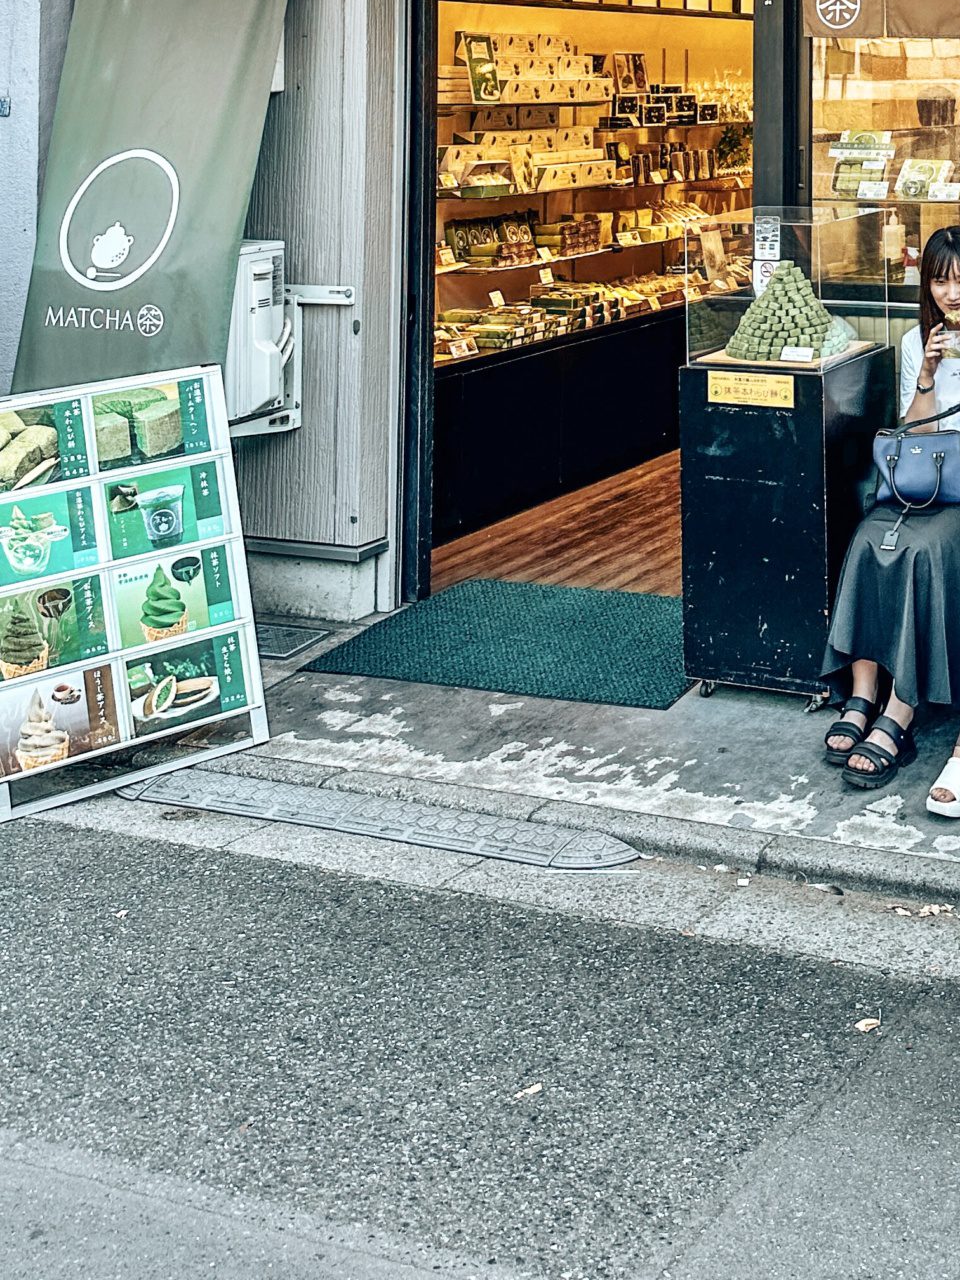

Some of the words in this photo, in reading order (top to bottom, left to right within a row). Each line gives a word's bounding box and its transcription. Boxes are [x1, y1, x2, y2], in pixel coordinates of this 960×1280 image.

[44, 305, 135, 331] MATCHA
[138, 306, 163, 334] 茶
[93, 670, 107, 725] ほうじ茶アイス
